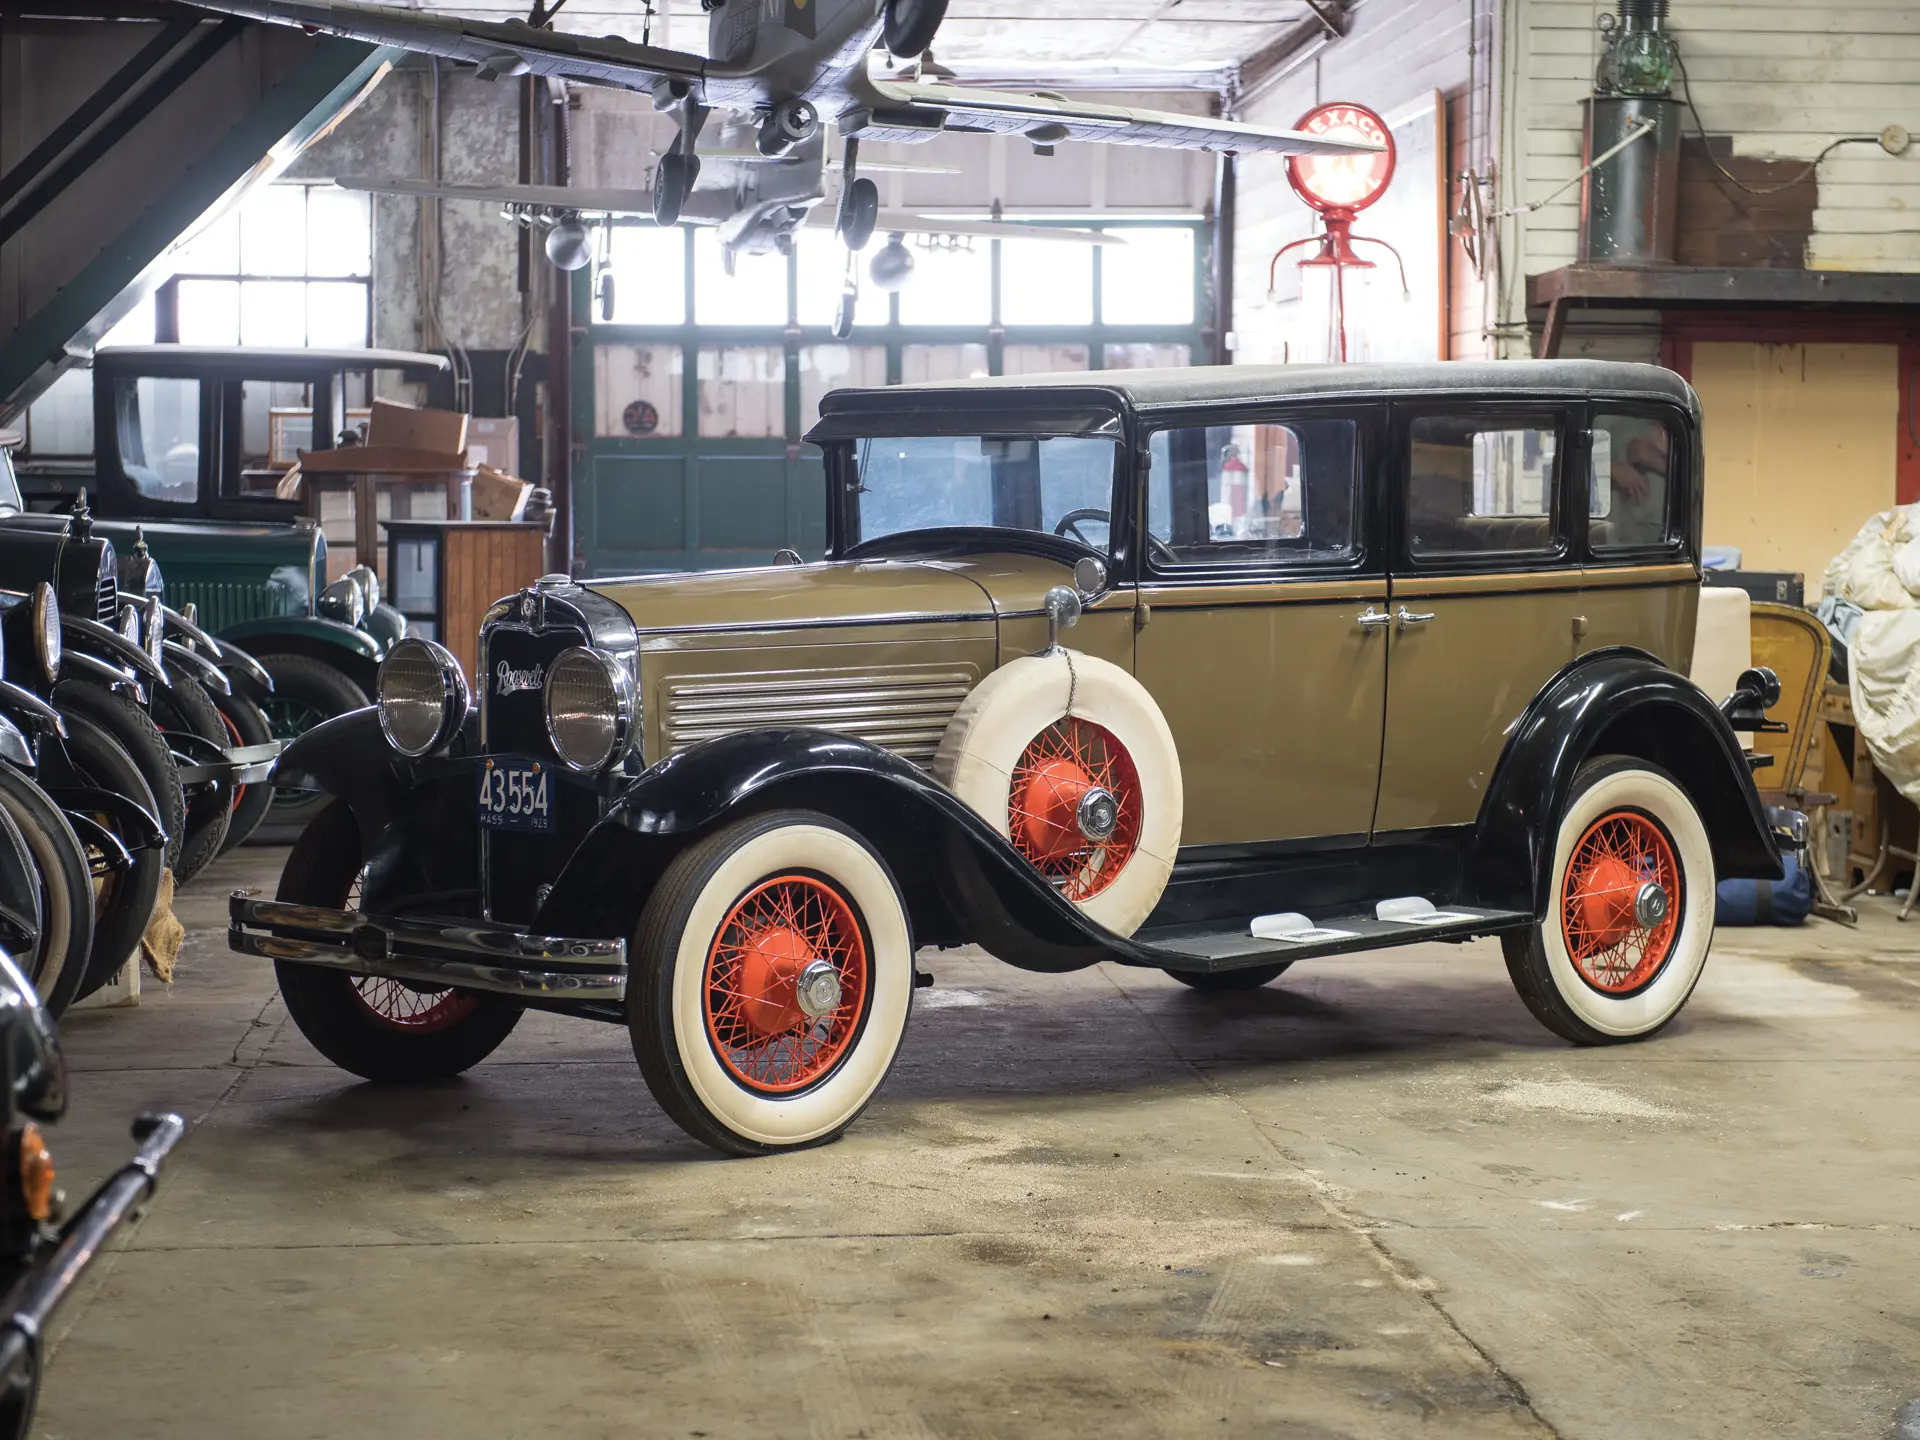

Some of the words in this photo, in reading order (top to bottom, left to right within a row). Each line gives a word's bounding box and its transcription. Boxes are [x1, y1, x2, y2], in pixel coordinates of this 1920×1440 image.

[1303, 110, 1386, 146] EXACO
[496, 660, 544, 696] Roosevelt
[480, 812, 503, 825] MASS
